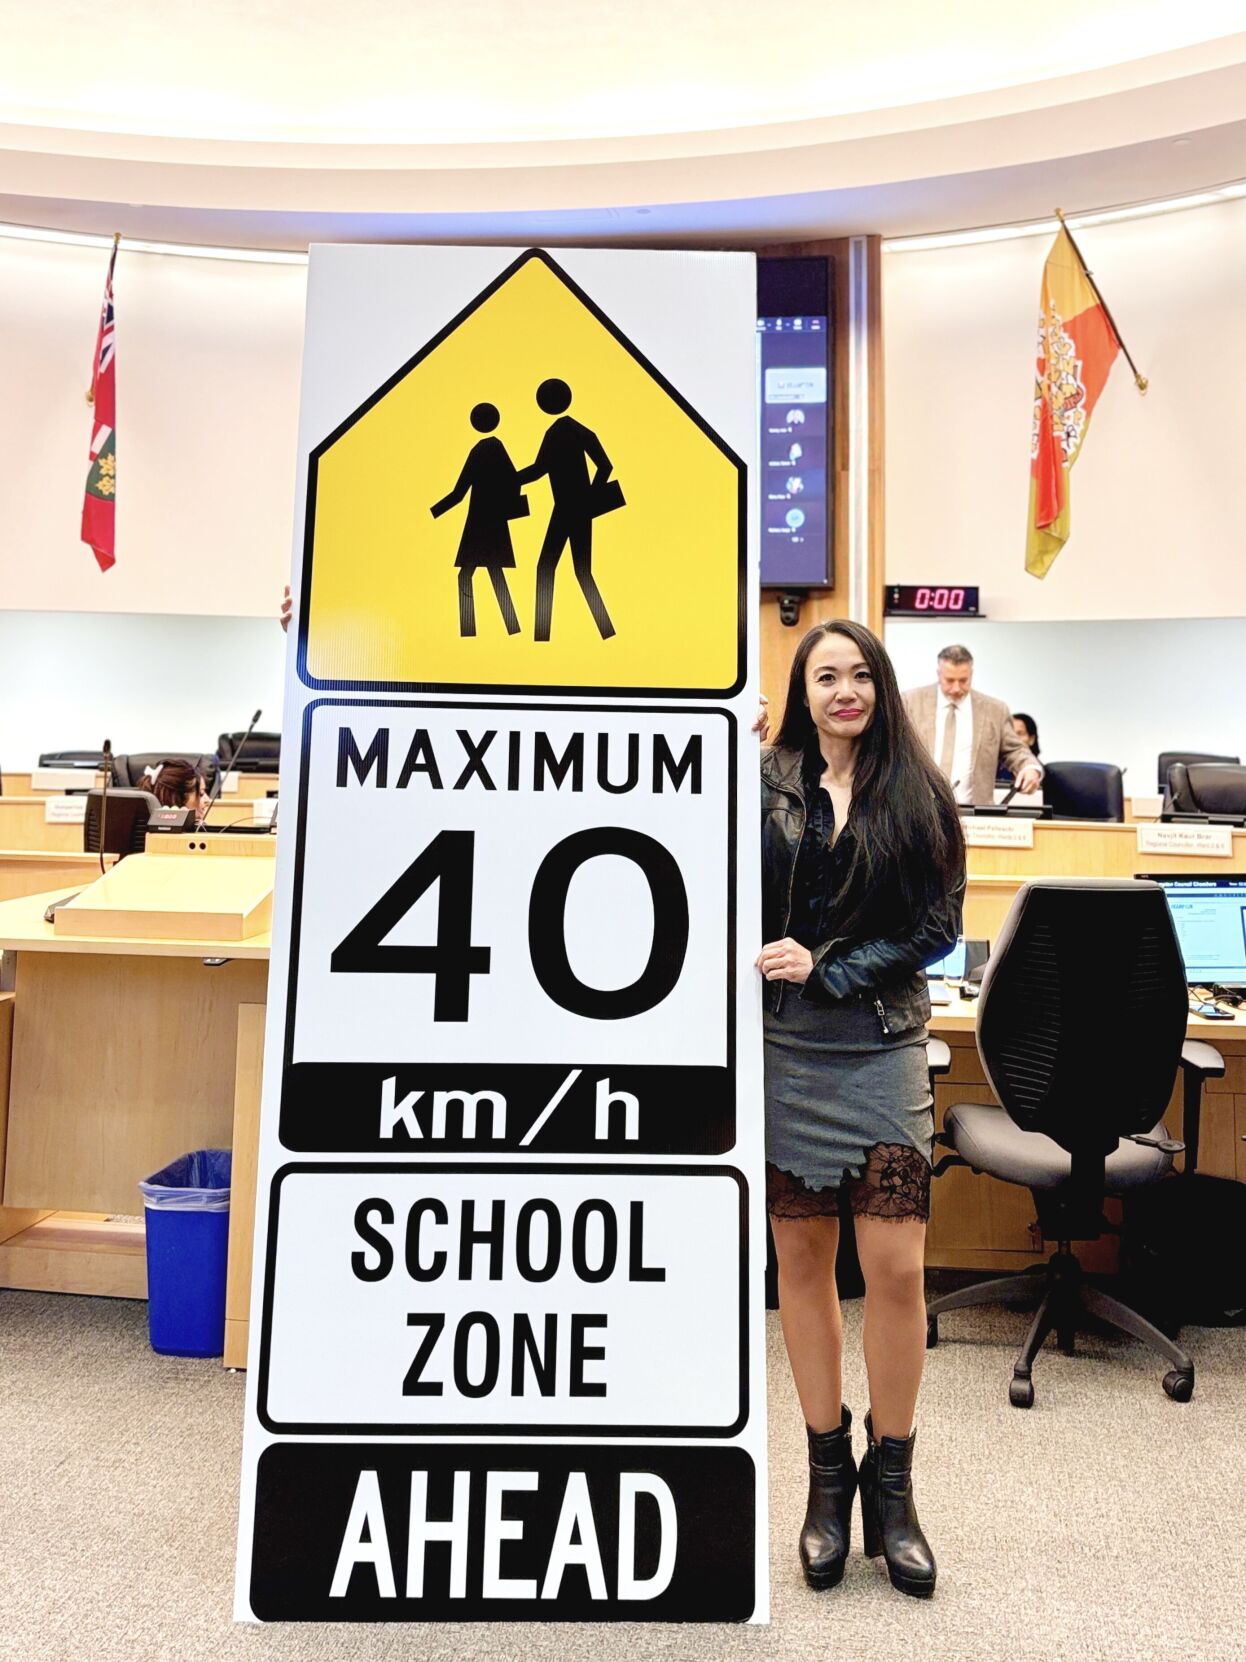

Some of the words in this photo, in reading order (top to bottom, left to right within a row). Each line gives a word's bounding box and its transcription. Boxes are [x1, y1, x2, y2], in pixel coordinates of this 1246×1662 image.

[914, 588, 965, 610] 0:00
[337, 727, 703, 795] MAXIMUM
[331, 827, 689, 1022] 40
[380, 1070, 640, 1146] km/h
[351, 1198, 666, 1283] SCHOOL
[403, 1311, 608, 1398] ZONE
[329, 1471, 678, 1600] AHEAD
